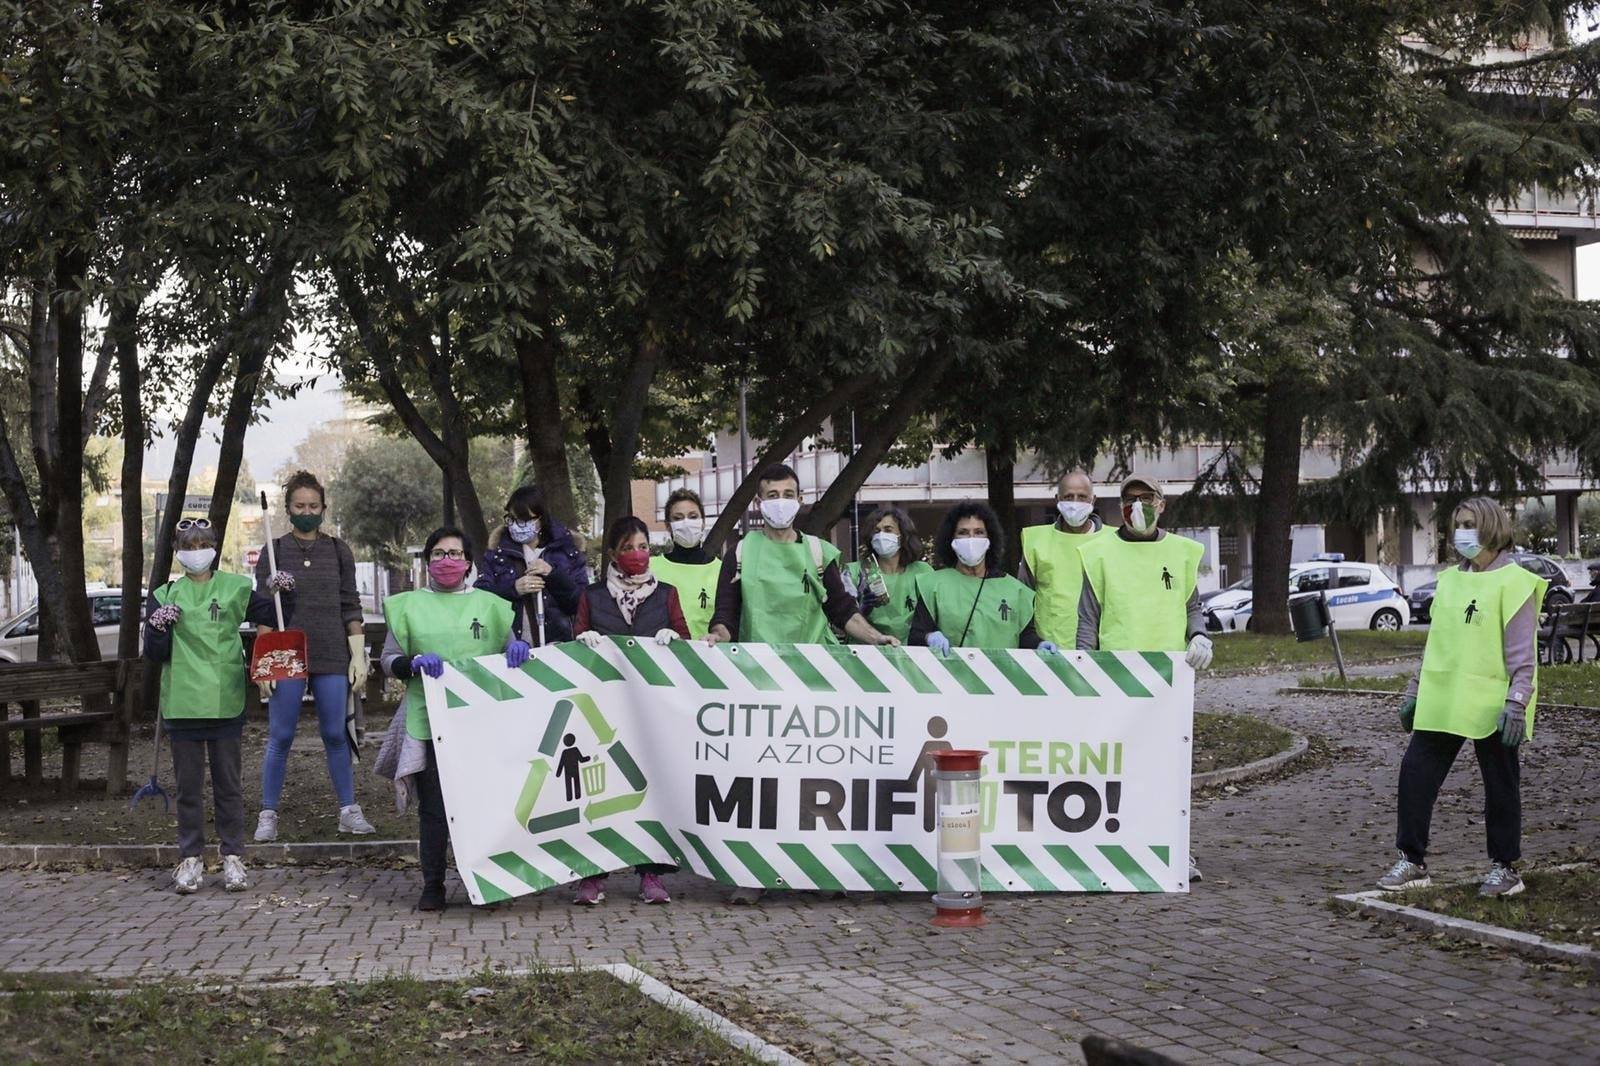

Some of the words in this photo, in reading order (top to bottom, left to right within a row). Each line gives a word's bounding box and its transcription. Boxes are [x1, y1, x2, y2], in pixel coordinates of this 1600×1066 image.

[695, 701, 895, 740] CITTADINI
[694, 741, 729, 762] IN
[756, 743, 894, 765] AZIONE
[988, 740, 1123, 776] TERNI
[695, 773, 779, 830] MI
